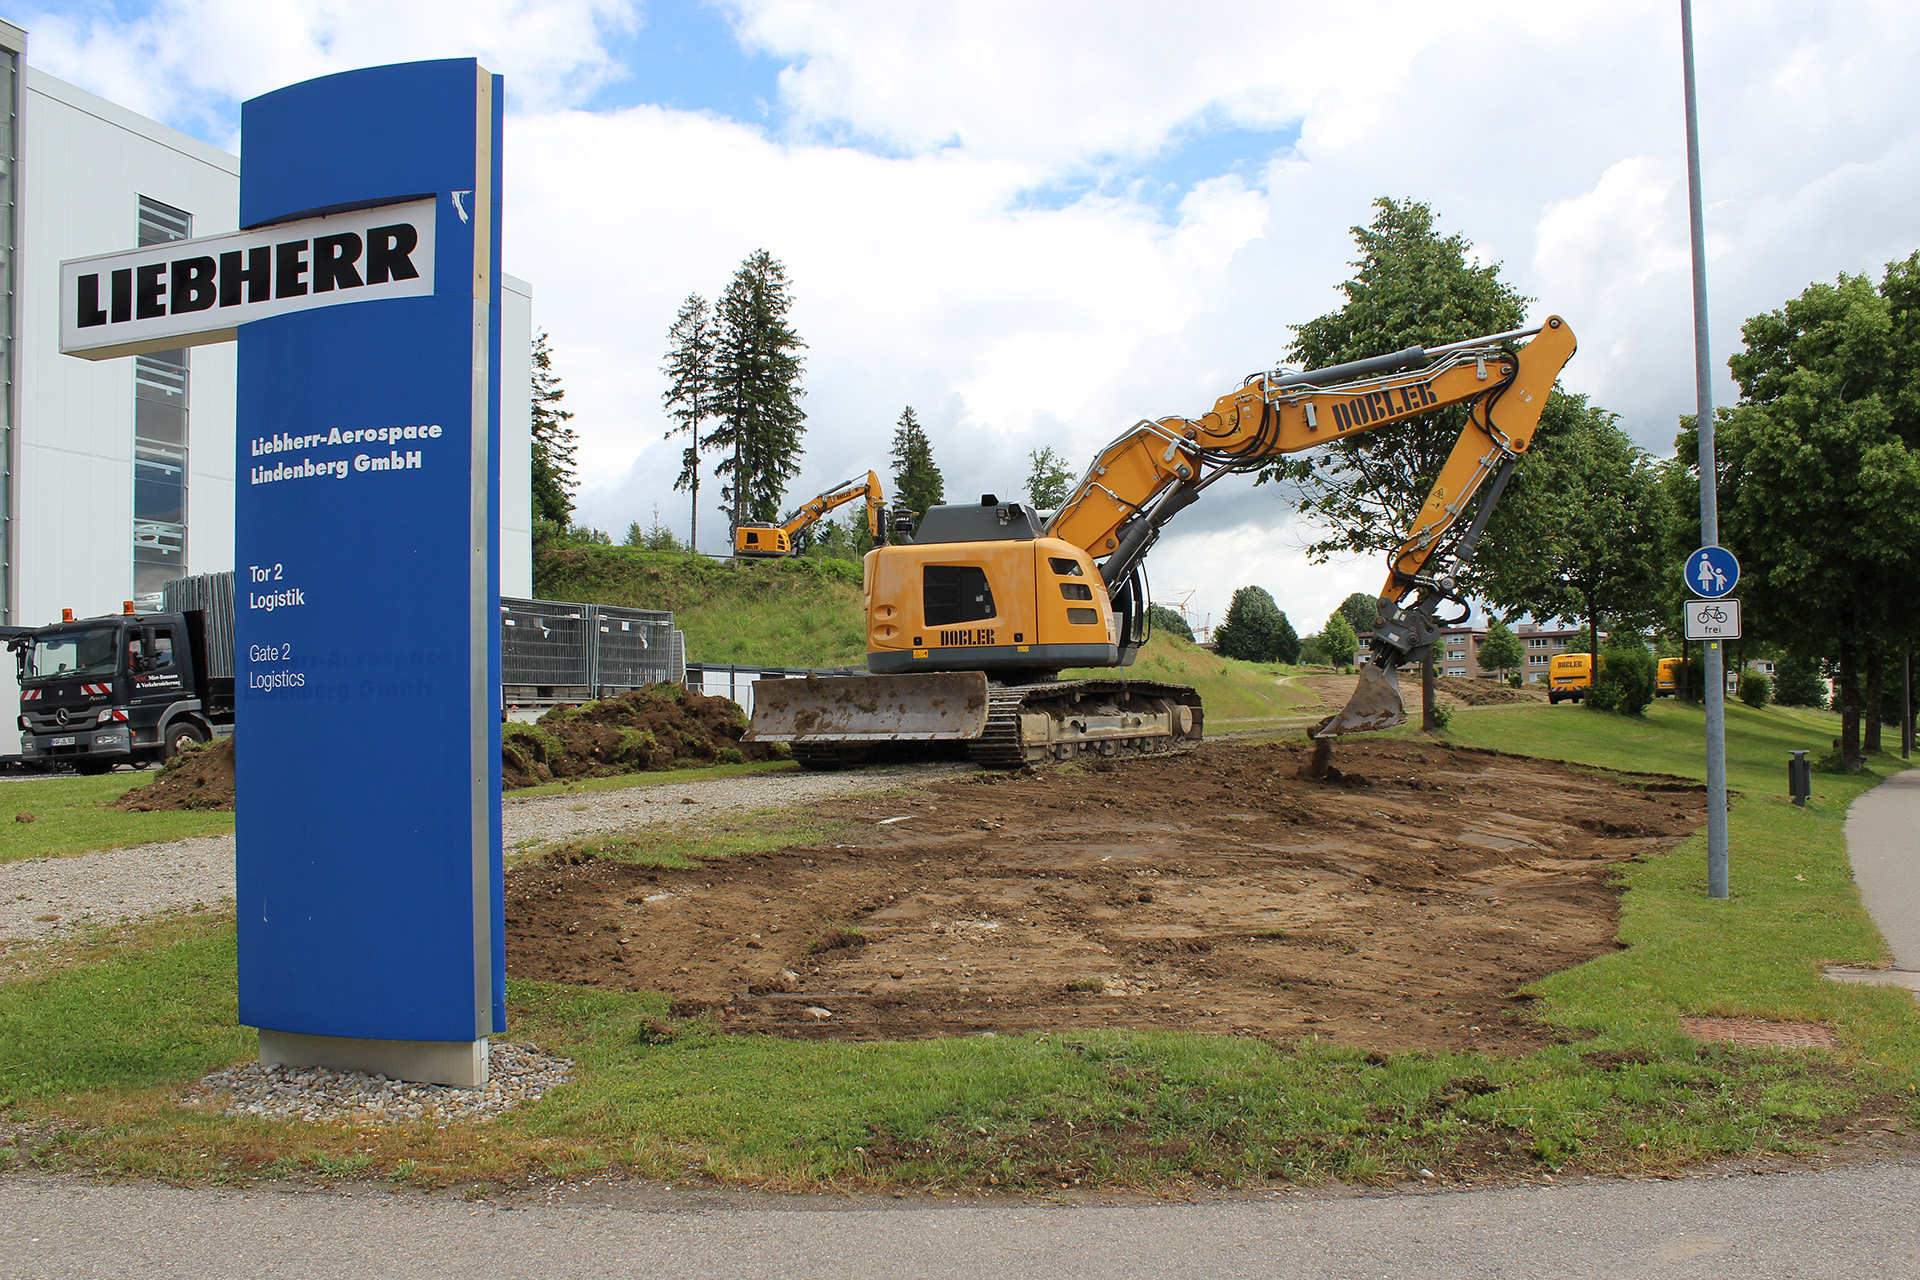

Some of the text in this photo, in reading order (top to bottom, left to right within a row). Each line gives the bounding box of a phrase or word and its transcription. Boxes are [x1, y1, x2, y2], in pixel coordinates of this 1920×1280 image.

[77, 223, 420, 328] LIEBHERR
[1331, 377, 1438, 432] DOBLER
[251, 424, 443, 456] Liebherr-Aerospace
[251, 450, 422, 485] Lindenberg GmbH
[250, 563, 283, 582] Tor 2
[250, 589, 305, 612] Logistik
[940, 629, 995, 646] DOBLER
[1704, 625, 1722, 634] frei
[250, 643, 291, 662] Gate 2
[250, 669, 305, 692] Logistics
